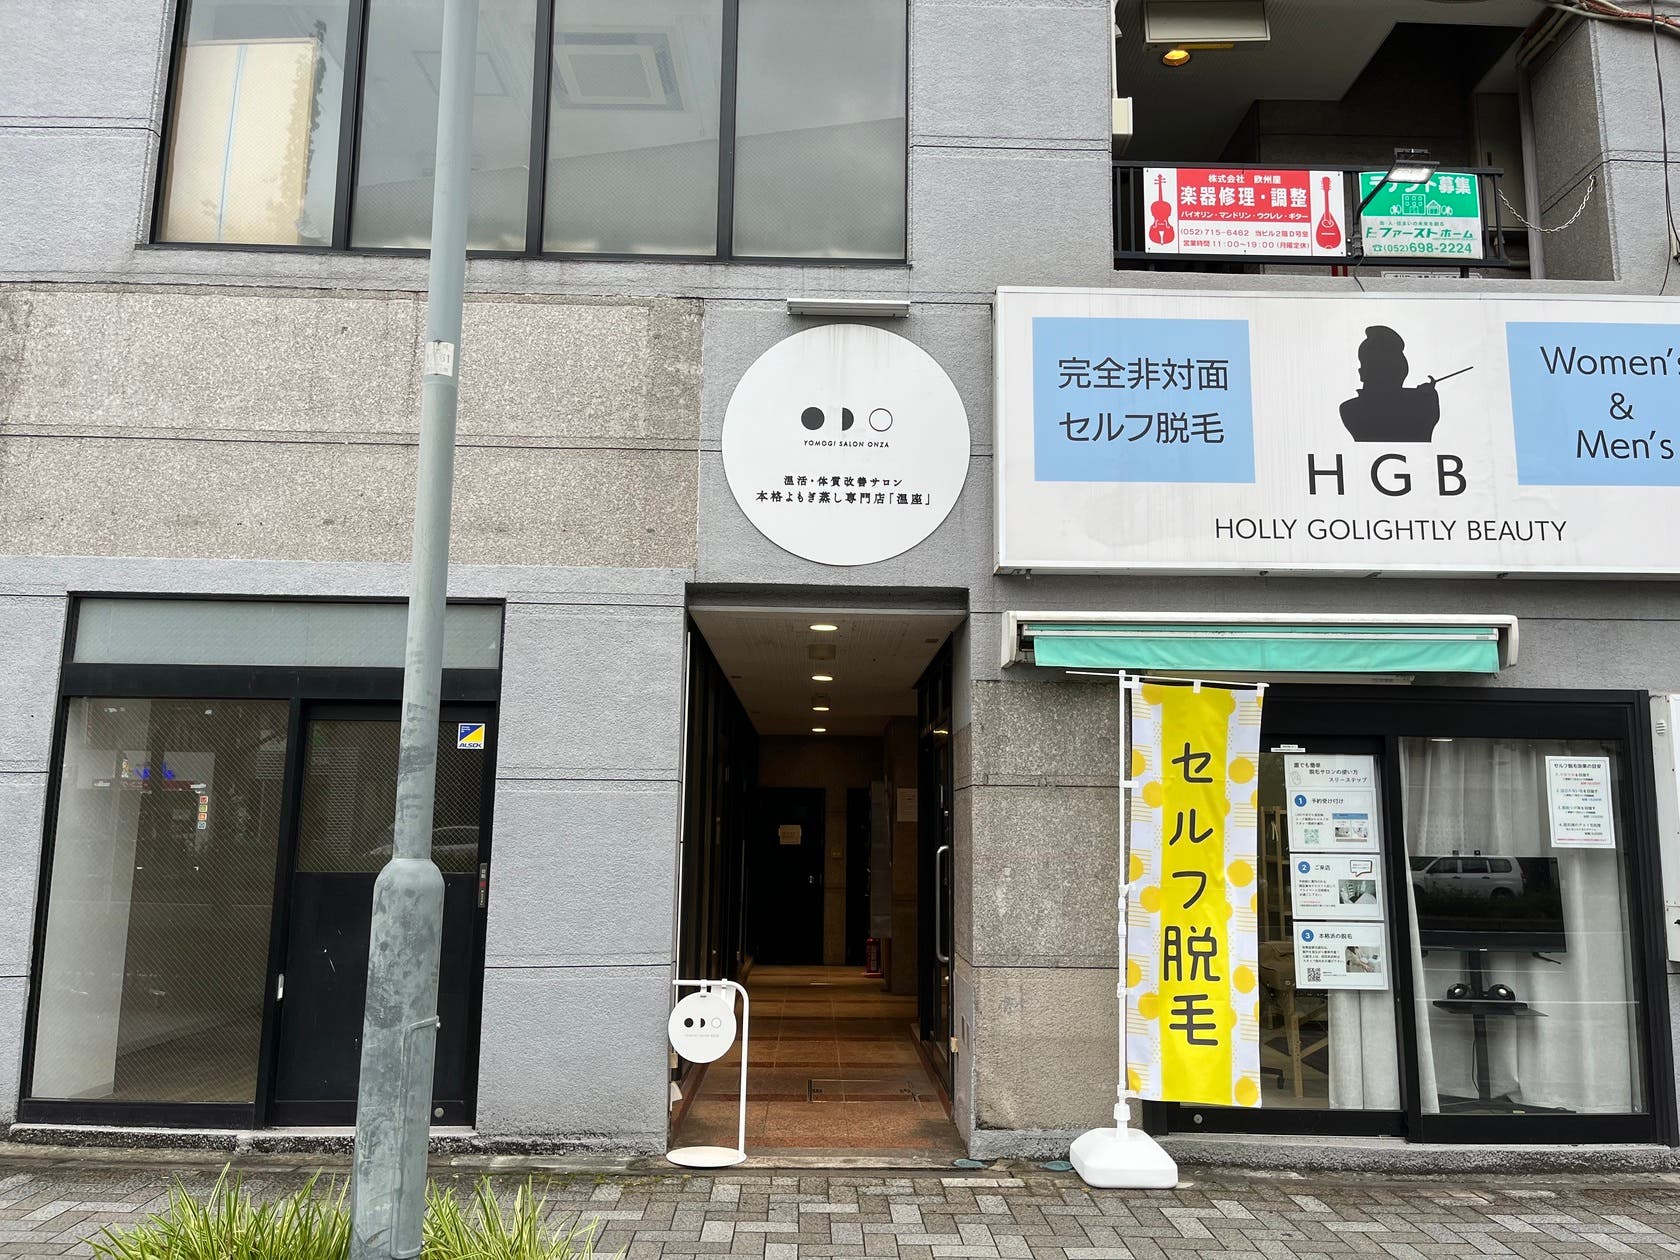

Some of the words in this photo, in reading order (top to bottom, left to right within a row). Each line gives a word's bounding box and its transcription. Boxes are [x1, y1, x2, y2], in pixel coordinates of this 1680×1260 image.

[1208, 174, 1245, 184] 株式会社
[1180, 186, 1308, 208] 楽器修理・調整
[1180, 228, 1249, 238] (052)715-6462
[1540, 346, 1680, 376] Women'
[1058, 357, 1229, 391] 完全非対面
[1609, 392, 1635, 420] &
[1058, 412, 1225, 444] セルフ脱毛
[803, 440, 836, 448] YOMOGI
[839, 440, 864, 448] SALON
[1576, 430, 1674, 460] Men's
[784, 475, 903, 487] 温活・体質改善サロン
[756, 490, 931, 506] 本格よもぎ蒸し専門店「温座」
[1215, 518, 1297, 540] HOLLY
[1307, 518, 1457, 541] GOLIGHTLY
[1467, 520, 1568, 542] BEAUTY
[1163, 742, 1221, 1047] セルフ脱毛
